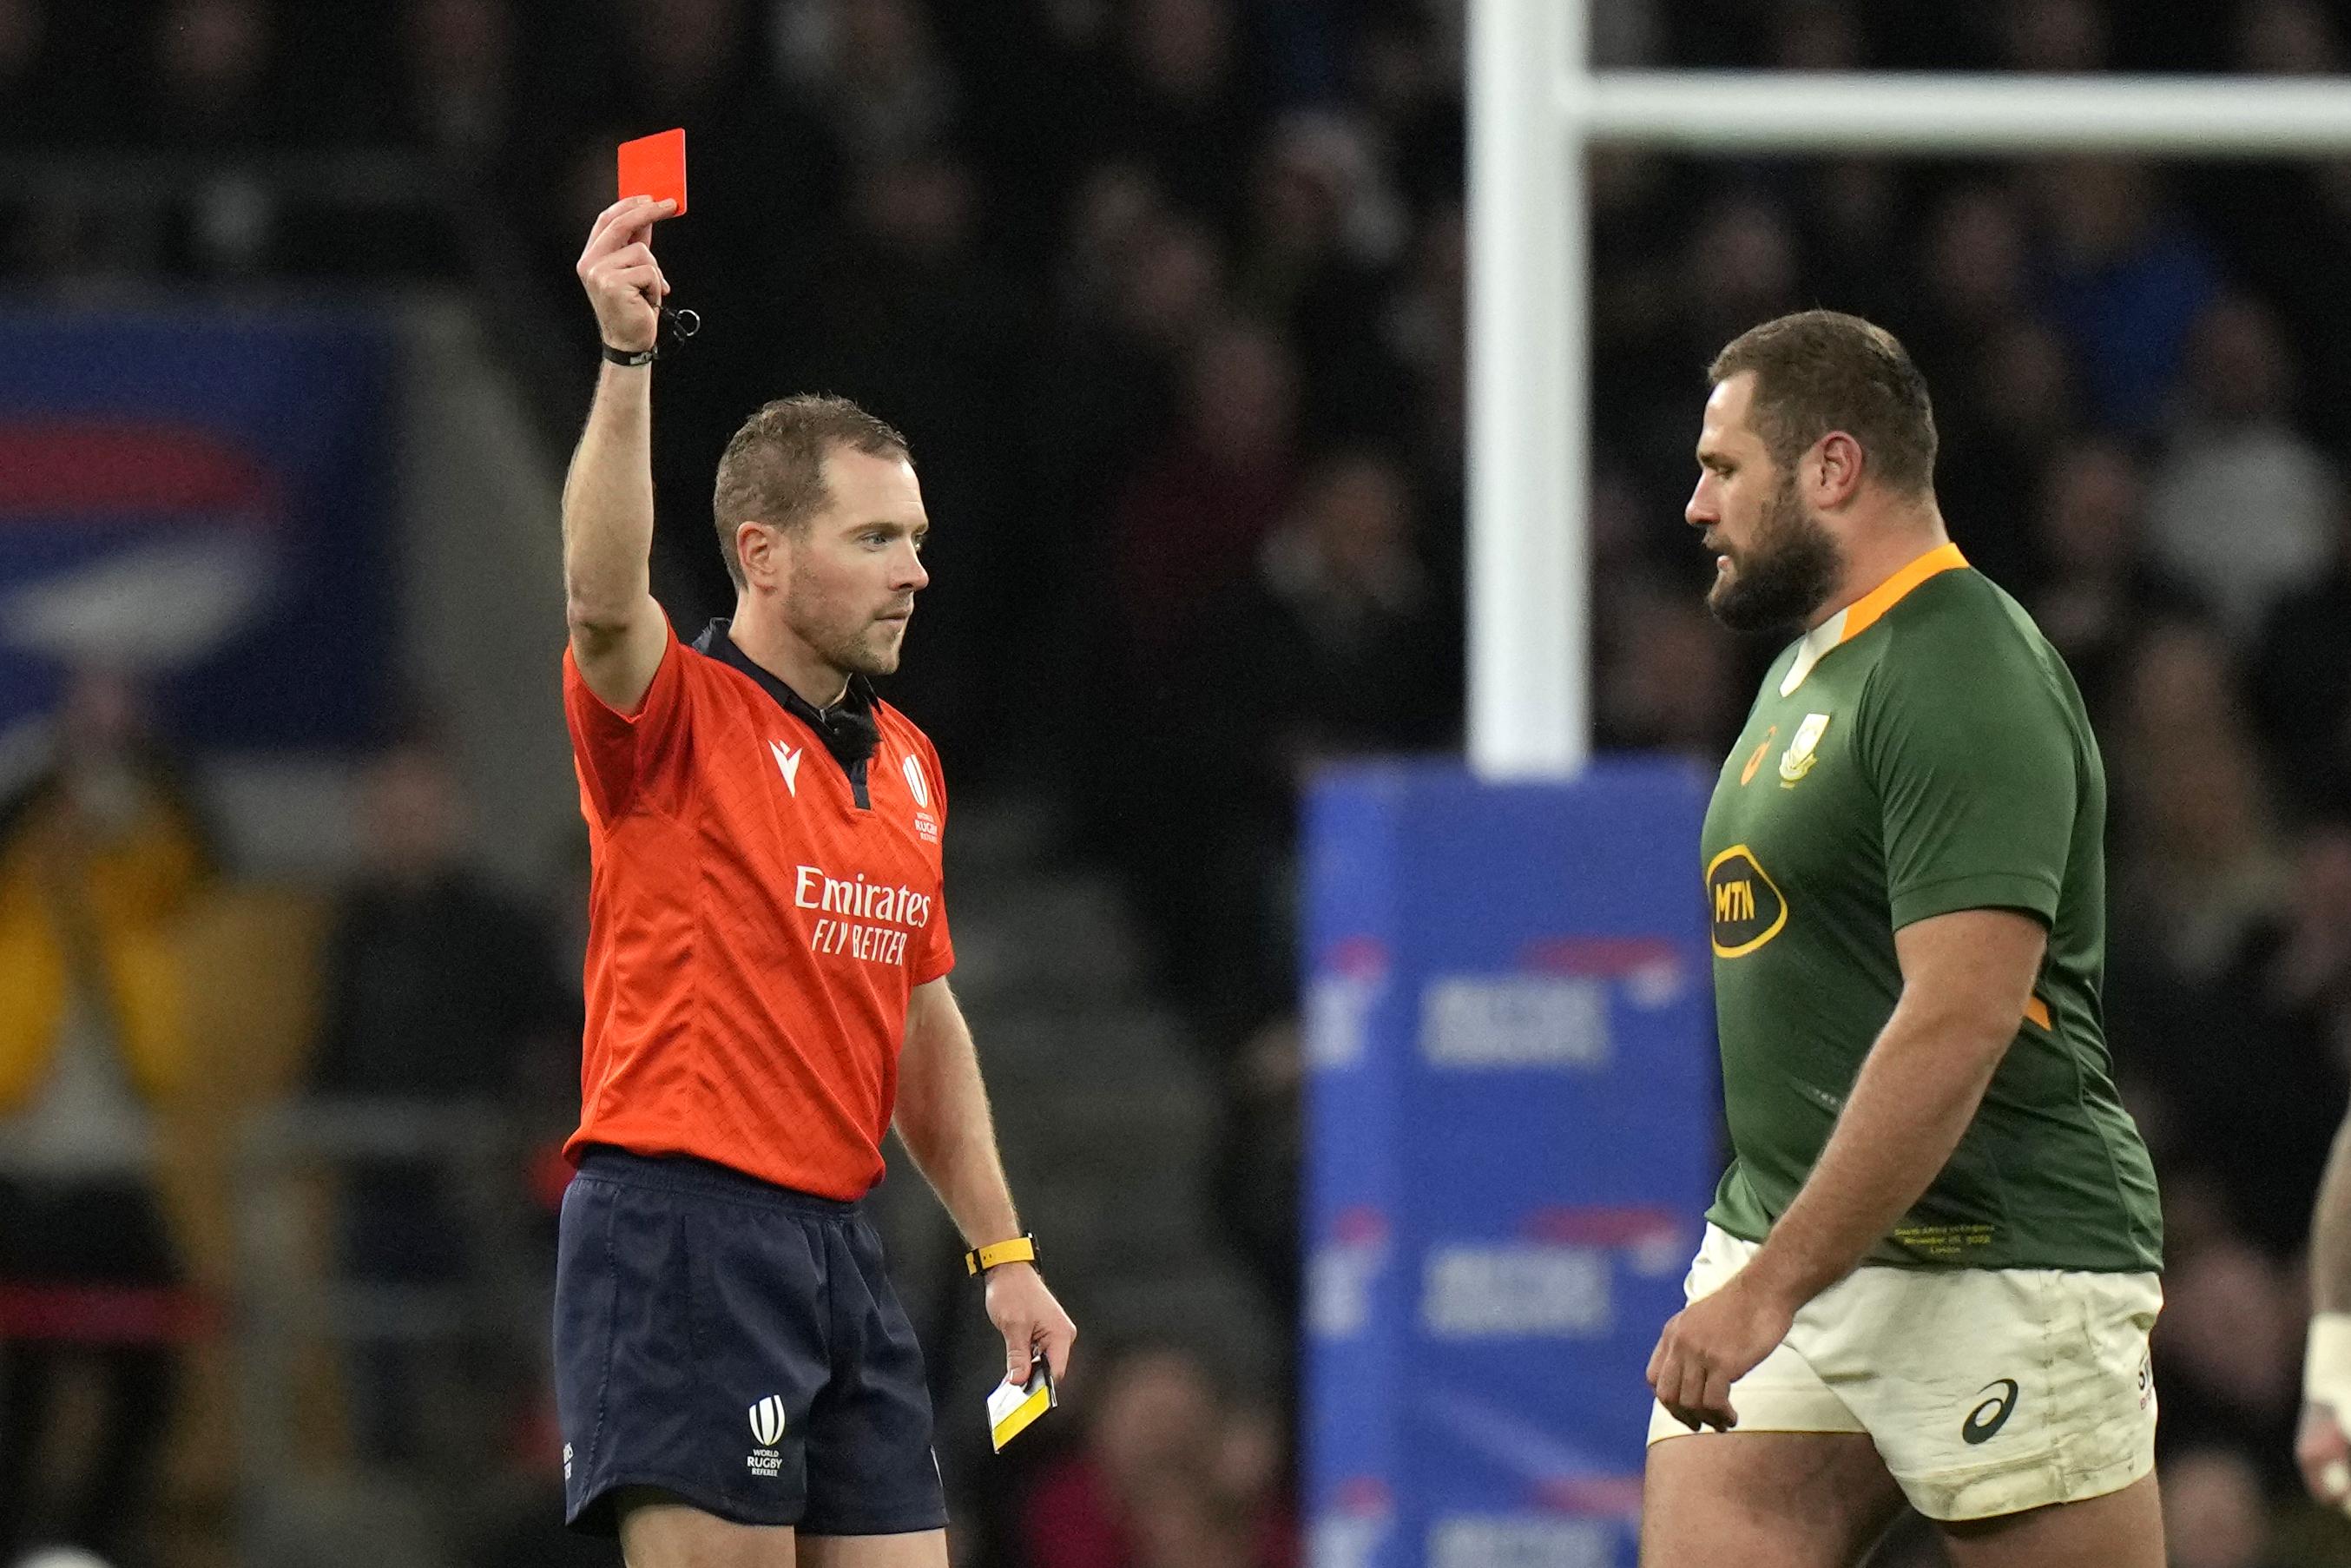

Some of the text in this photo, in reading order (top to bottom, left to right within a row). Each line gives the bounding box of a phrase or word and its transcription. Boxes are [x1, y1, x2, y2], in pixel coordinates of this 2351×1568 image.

[795, 865, 931, 928] Emirates
[1715, 880, 1755, 923] MTN
[812, 919, 908, 966] FLY BETTER
[747, 1456, 783, 1470] RUGBY
[753, 1449, 780, 1458] WORLD
